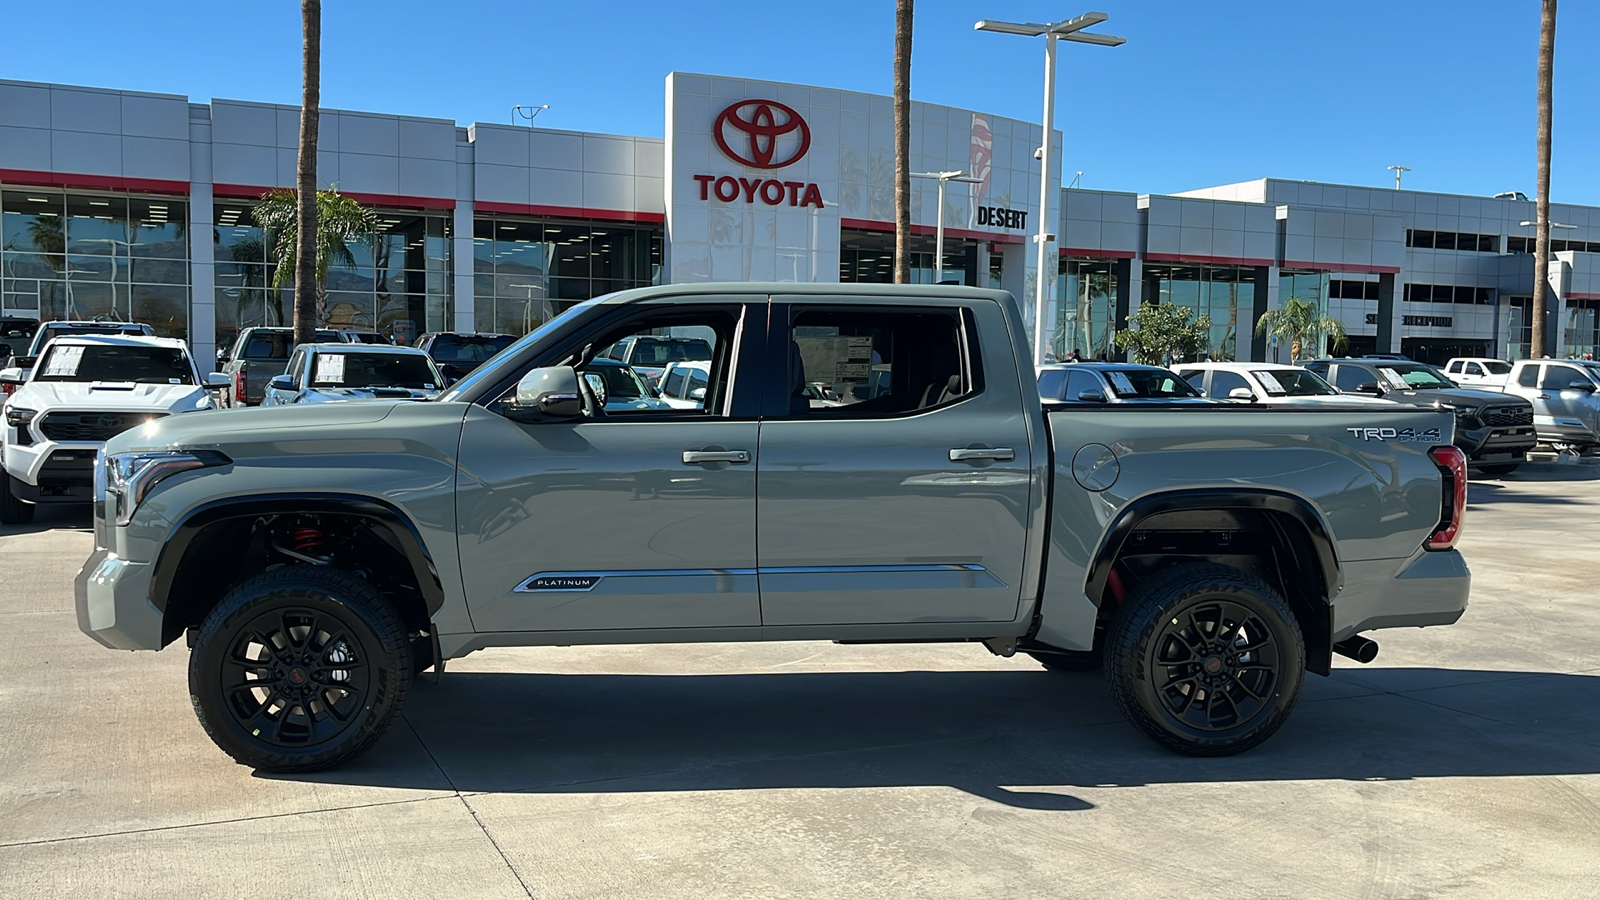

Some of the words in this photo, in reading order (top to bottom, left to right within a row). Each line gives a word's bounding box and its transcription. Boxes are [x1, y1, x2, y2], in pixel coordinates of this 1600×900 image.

[693, 174, 825, 208] TOYOTA
[977, 206, 1028, 230] DESERT
[1347, 427, 1398, 441] TRD
